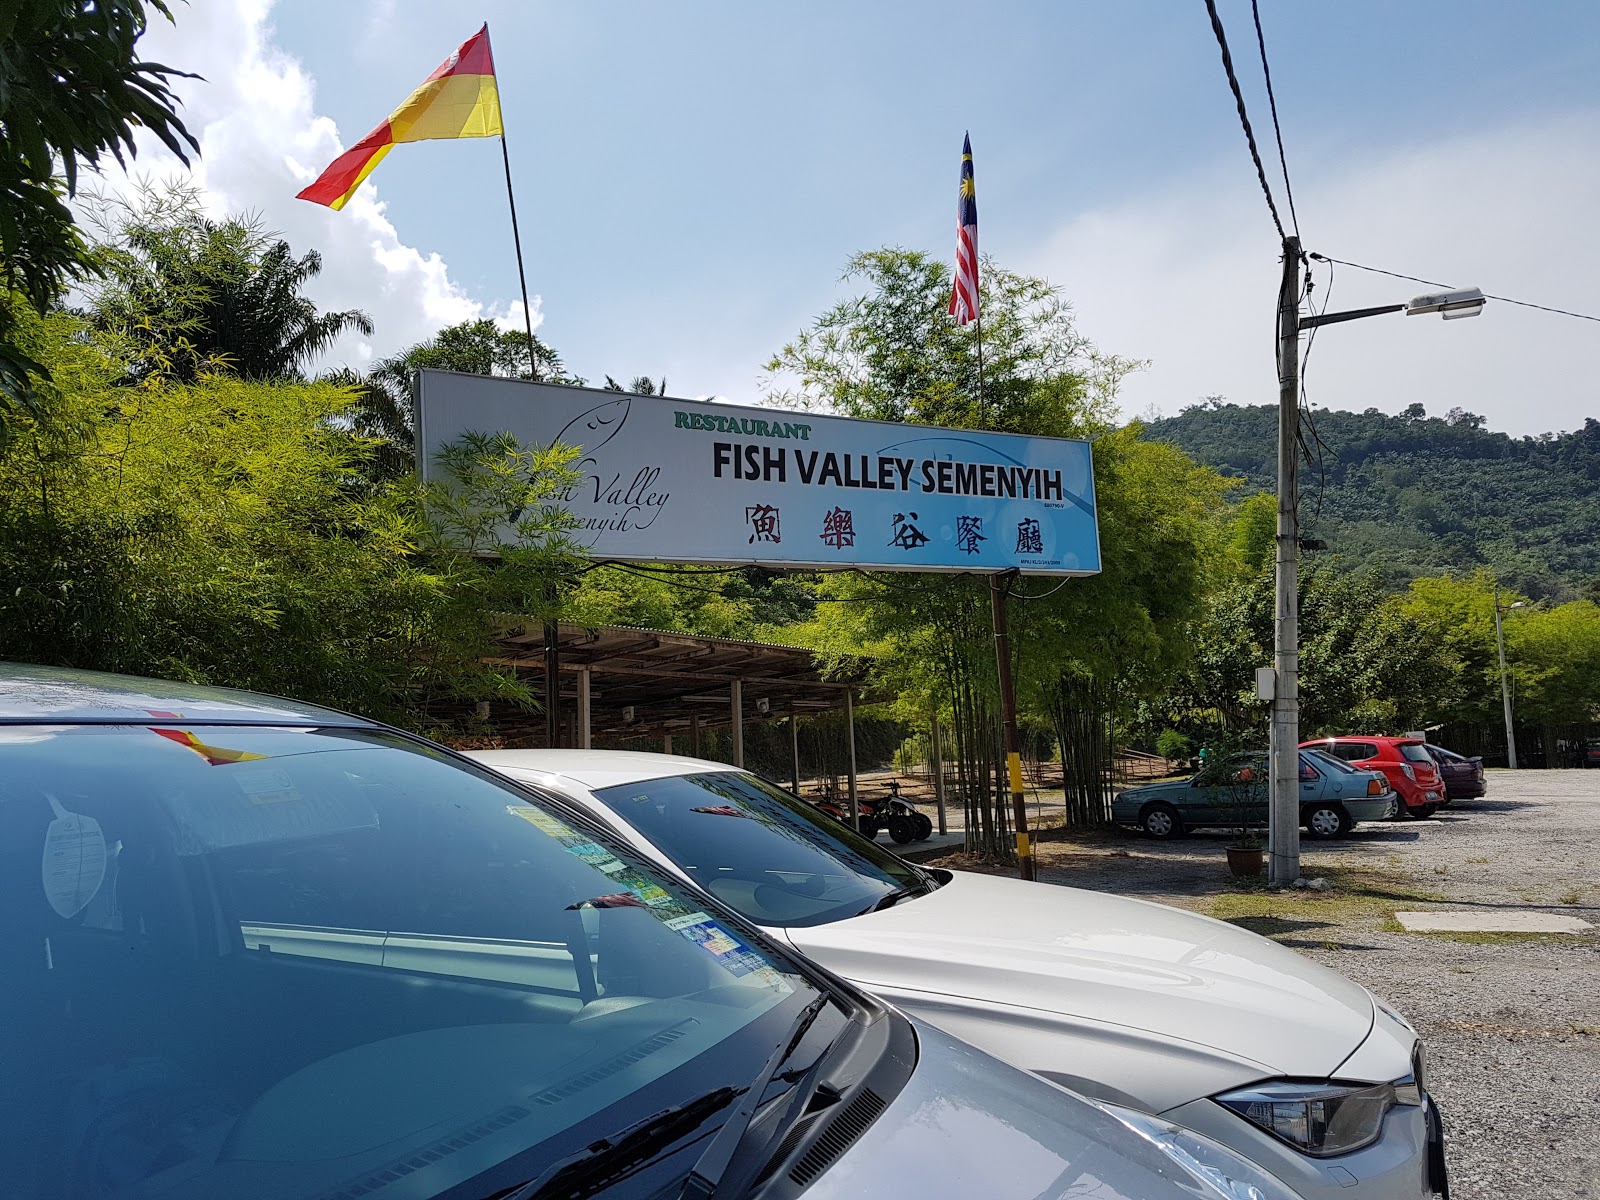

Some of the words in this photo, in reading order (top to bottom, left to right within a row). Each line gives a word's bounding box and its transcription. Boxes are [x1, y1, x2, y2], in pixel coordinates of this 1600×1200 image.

[674, 411, 811, 440] RESTAURANT
[586, 466, 670, 529] Valley
[713, 442, 786, 482] FISH
[794, 449, 914, 491] VALLEY
[921, 459, 1063, 500] SEMENYIH
